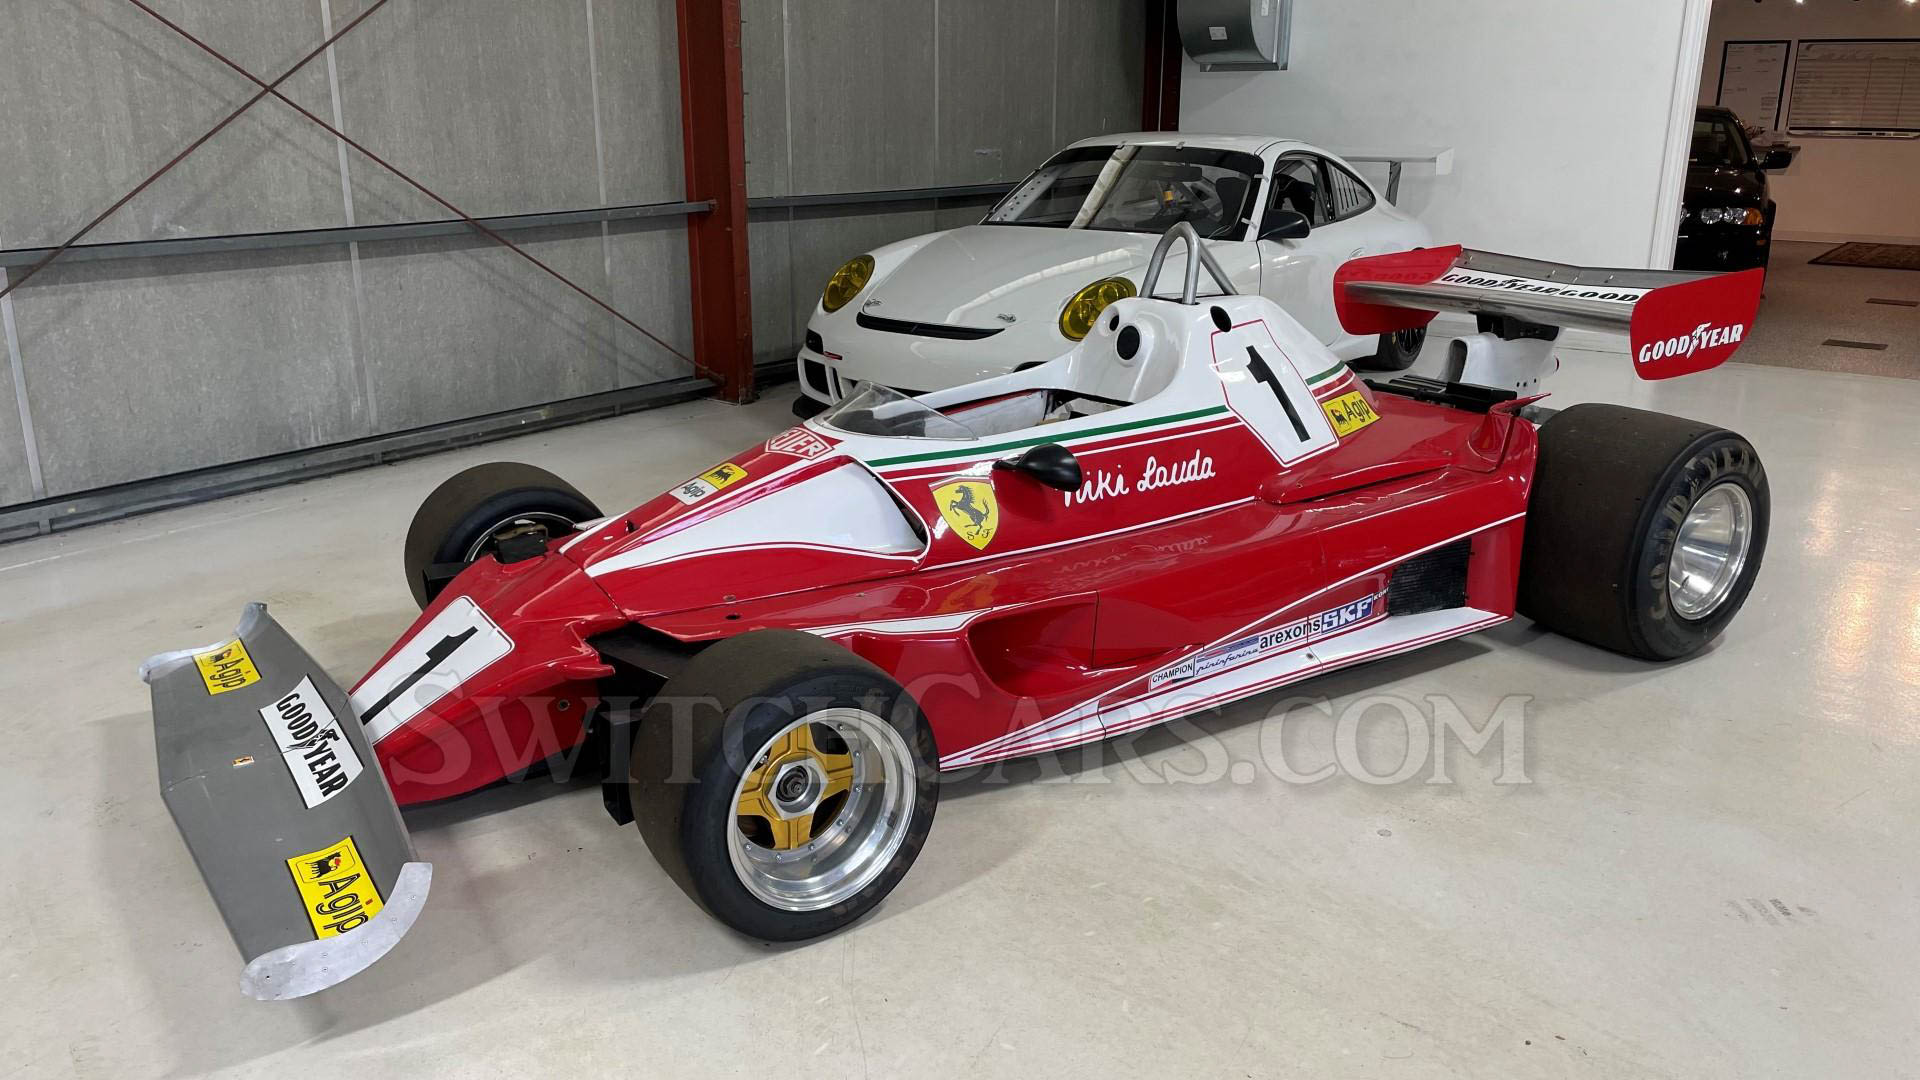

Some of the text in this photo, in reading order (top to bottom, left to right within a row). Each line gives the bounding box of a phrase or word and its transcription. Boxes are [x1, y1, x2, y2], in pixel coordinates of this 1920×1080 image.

[1560, 289, 1639, 302] GOOD
[1246, 345, 1311, 442] 1
[1341, 396, 1371, 422] Agip
[1137, 449, 1216, 492] Lauda
[681, 482, 706, 498] Agip
[966, 530, 975, 541] S
[1322, 597, 1372, 633] SKF
[1260, 619, 1320, 649] arexons
[210, 657, 250, 688] Agip
[360, 626, 478, 725] 1
[1152, 662, 1193, 683] CHAMPION
[1196, 648, 1258, 675] pininfarina
[316, 873, 373, 933] Agip
